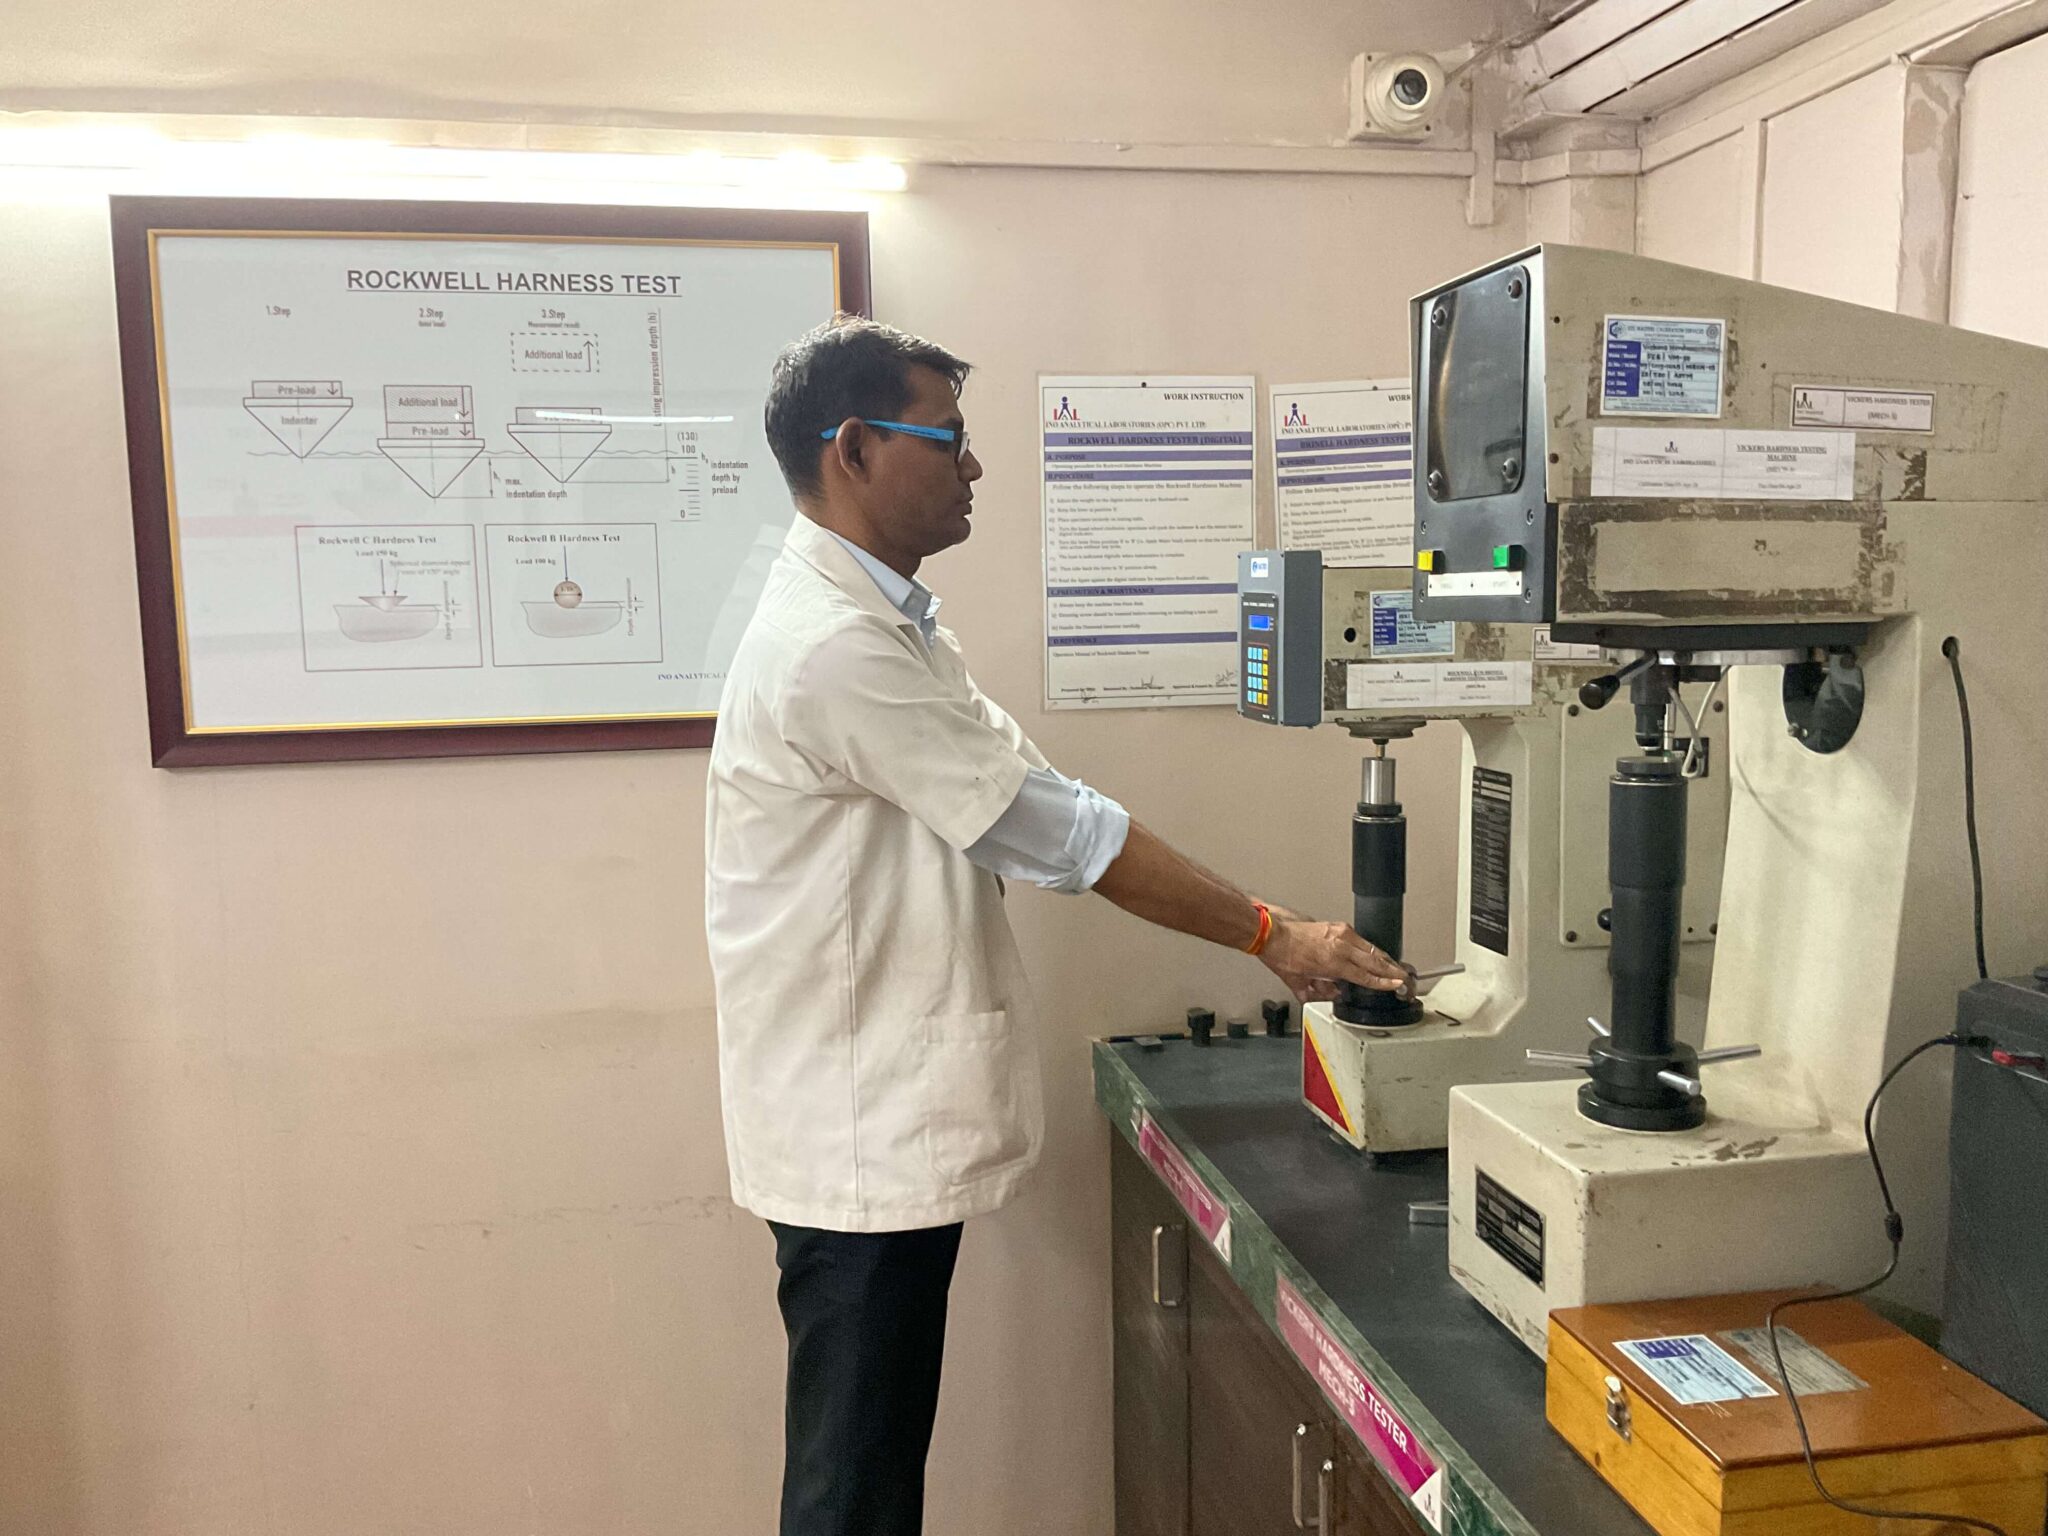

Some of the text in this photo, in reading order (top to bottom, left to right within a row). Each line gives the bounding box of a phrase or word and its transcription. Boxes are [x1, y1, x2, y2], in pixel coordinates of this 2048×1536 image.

[347, 270, 681, 293] ROCKWELL HARNESS TEST
[418, 307, 444, 320] 2.Step
[540, 308, 566, 321] 3.Step
[524, 350, 584, 360] Additional load
[278, 384, 317, 396] Pre-load
[1163, 392, 1244, 401] WORK INSTRUCTION
[1847, 396, 1873, 404] VICKERS
[398, 397, 458, 407] Additional load
[1045, 421, 1059, 429] INO
[1060, 421, 1102, 429] ANALYTICAL
[1104, 421, 1155, 429] LABORATORIES
[1295, 426, 1336, 434] ANALYTICAL
[1337, 424, 1384, 432] LABORATORIES
[412, 426, 450, 436] Pre-load
[676, 431, 699, 443] (130)
[1067, 435, 1243, 445] ROCKWELL HARDNESS TESTER (DIGITAL)
[1300, 440, 1335, 449] BRINELL
[1336, 437, 1380, 447] HARDNESS
[681, 445, 696, 454] 100
[1767, 454, 1797, 462] MACHINE
[710, 460, 749, 470] indentation
[711, 473, 741, 485] depth by
[505, 489, 568, 501] indentation depth
[711, 485, 738, 496] preload
[680, 509, 686, 519] 0
[318, 536, 437, 545] Rockwell C Hardness Test
[507, 534, 621, 543] Rockwell B Hardness Test
[657, 673, 672, 681] INO
[674, 672, 721, 680] ANALYTICAL
[1314, 1327, 1366, 1404] HARDNESS
[1366, 1391, 1408, 1456] TESTER
